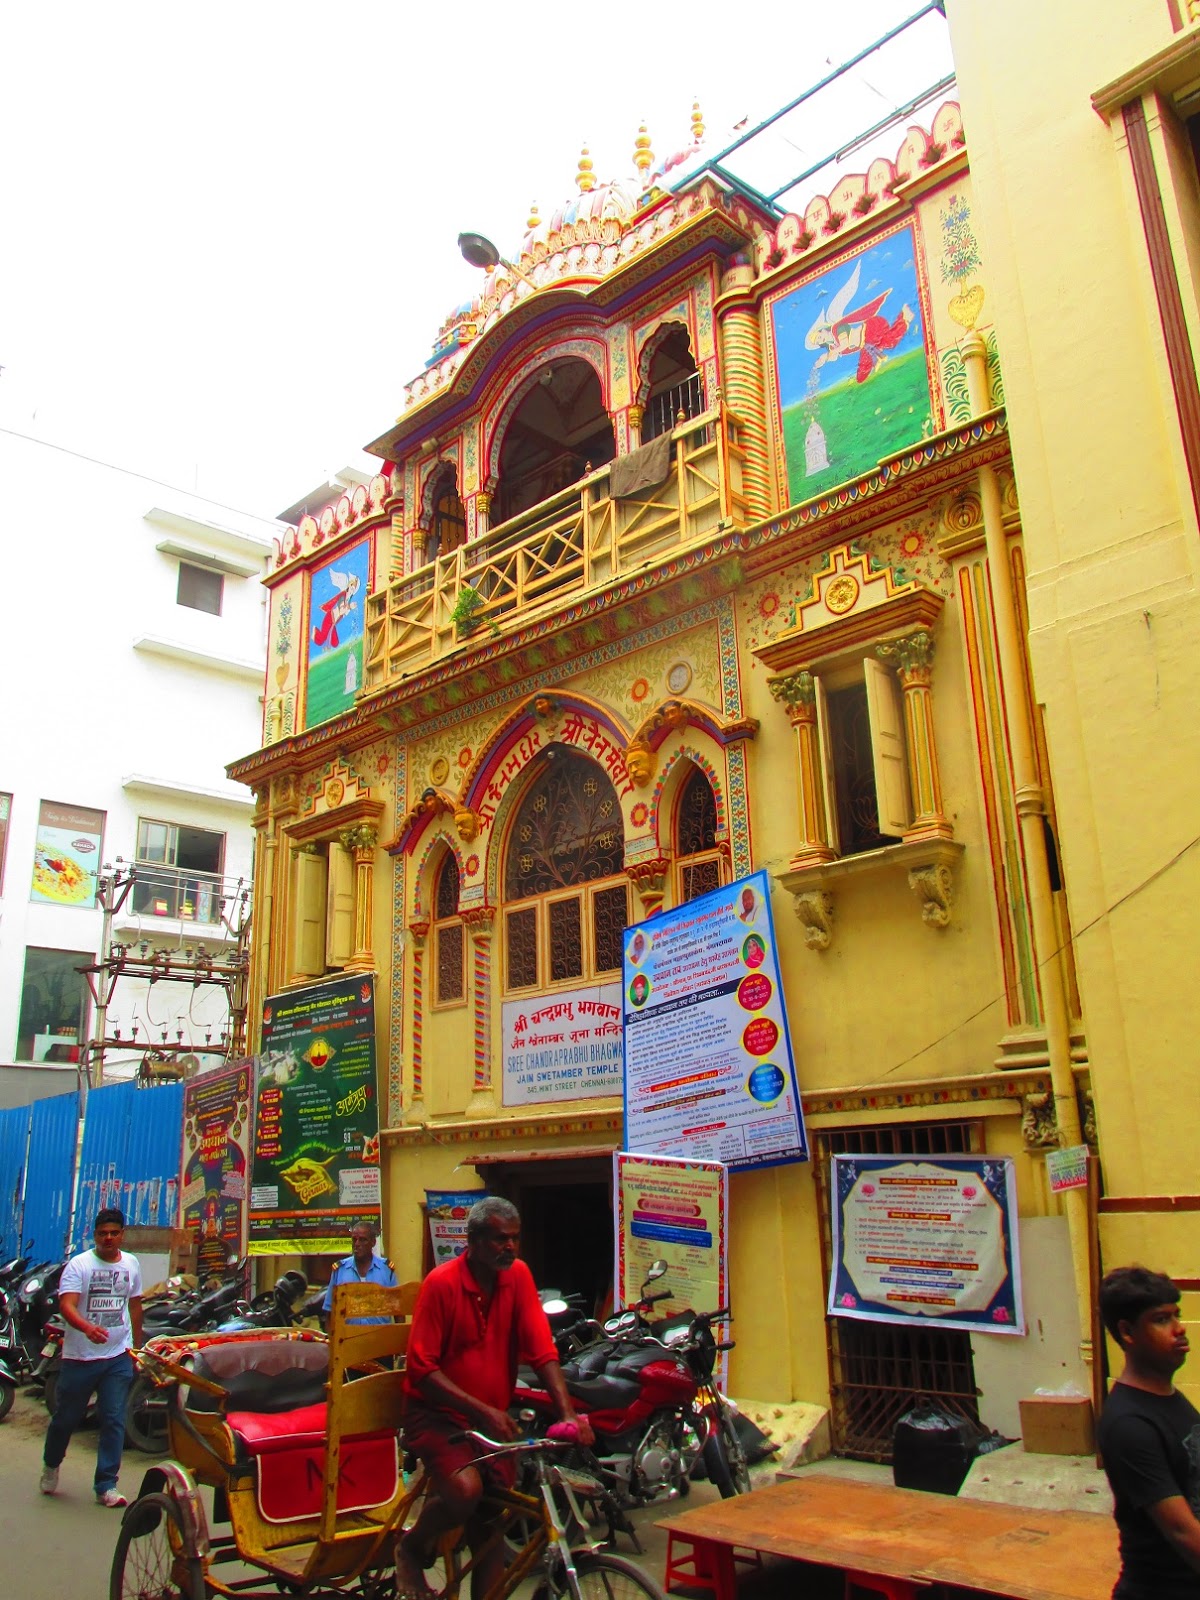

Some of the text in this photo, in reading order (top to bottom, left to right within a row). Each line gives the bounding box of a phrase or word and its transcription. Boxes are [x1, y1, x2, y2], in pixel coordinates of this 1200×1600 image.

[560, 713, 586, 743] श्री
[583, 722, 611, 760] जैन
[514, 1001, 621, 1034] श्री चन्द्रप्रभु भगवान
[511, 1035, 525, 1050] जैन
[569, 1028, 590, 1043] जूना
[508, 1041, 623, 1073] SREE CHANDRAPRABHU BHAGWA
[517, 1074, 534, 1085] JAIN
[537, 1067, 583, 1082] SWETAMBER
[587, 1063, 619, 1076] TEMPLE
[539, 1084, 552, 1093] MINT
[555, 1081, 577, 1091] STREET
[92, 1299, 113, 1308] DUNK
